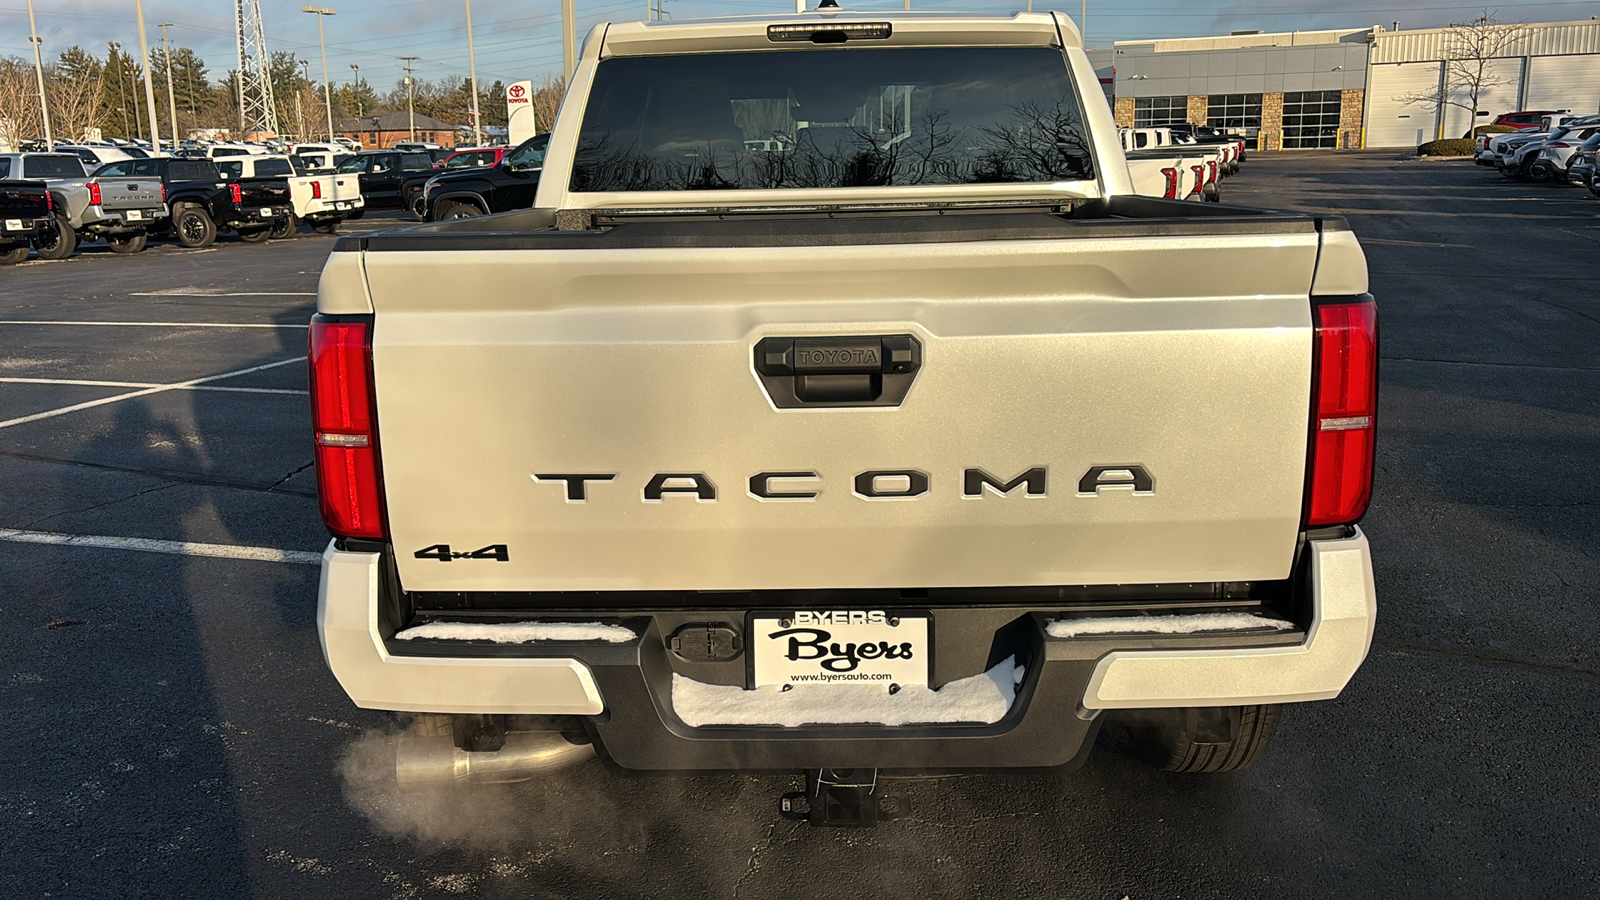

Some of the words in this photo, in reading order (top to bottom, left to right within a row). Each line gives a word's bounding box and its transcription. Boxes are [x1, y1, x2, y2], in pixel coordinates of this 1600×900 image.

[799, 350, 878, 365] TOYOTA
[530, 464, 1156, 503] TACOMA
[414, 543, 509, 563] 4x4
[794, 610, 887, 625] BYERS
[768, 628, 913, 672] Byers
[790, 672, 892, 682] www.byersauto.com
